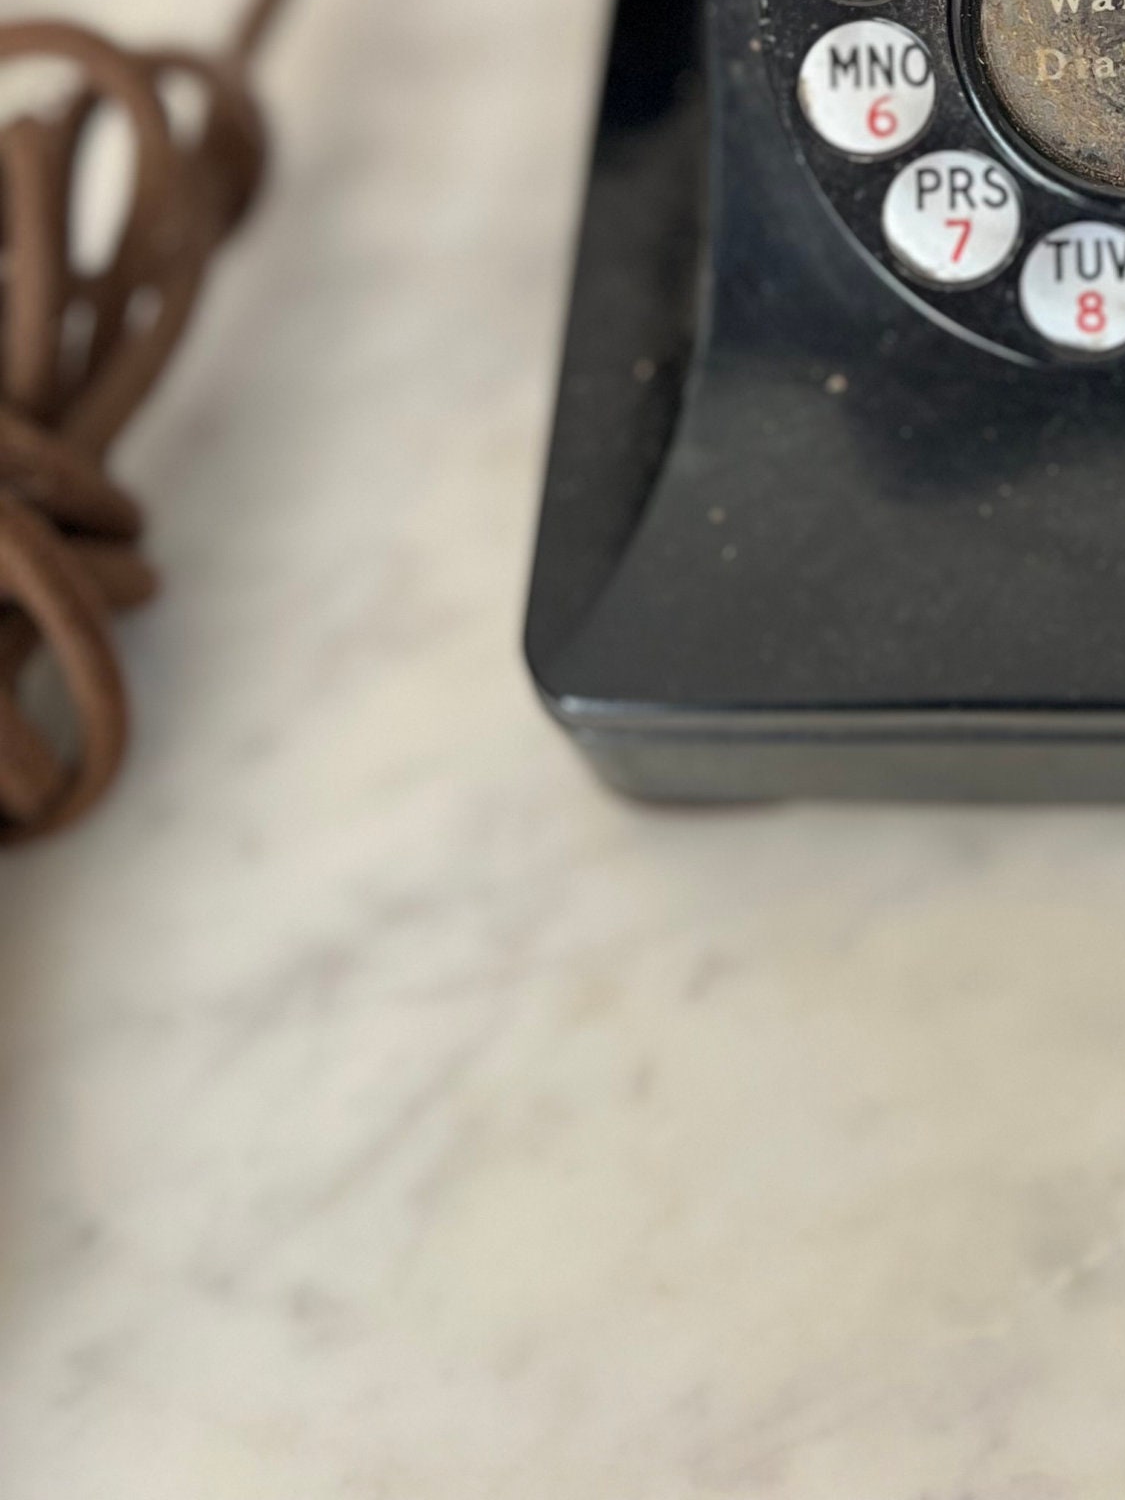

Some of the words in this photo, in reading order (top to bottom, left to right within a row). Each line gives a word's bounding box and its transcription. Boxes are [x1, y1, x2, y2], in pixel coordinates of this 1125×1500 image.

[829, 44, 931, 89] MNO
[866, 97, 898, 138] 6
[916, 166, 1009, 210] PRS
[944, 218, 973, 263] 7
[1075, 290, 1106, 334] 8
